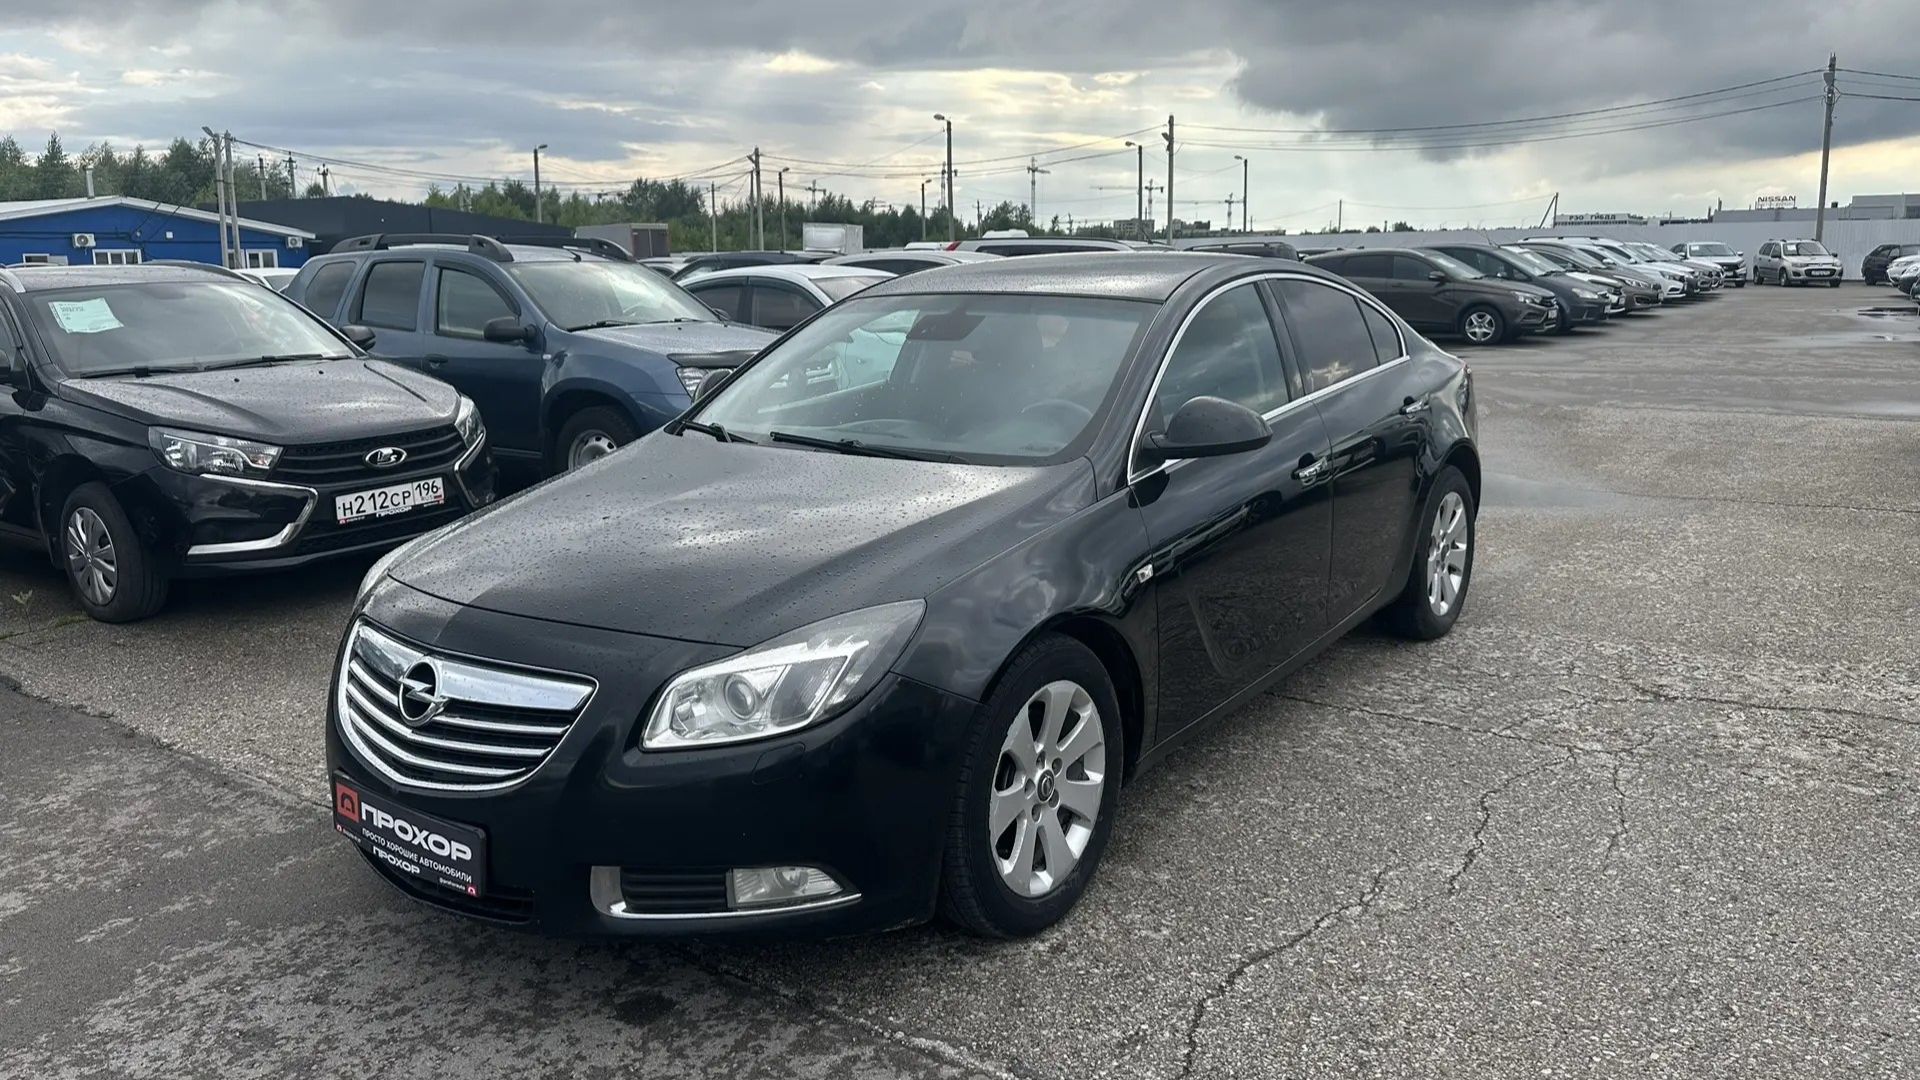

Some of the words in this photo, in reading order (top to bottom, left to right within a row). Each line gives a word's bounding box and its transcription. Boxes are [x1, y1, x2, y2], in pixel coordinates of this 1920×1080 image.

[415, 480, 439, 496] 196
[361, 802, 472, 861] ПРОХОР
[362, 828, 387, 847] ПРОСТО
[386, 840, 418, 863] ХОРОШИЕ
[419, 857, 472, 883] АВТОМОБИЛИ
[373, 846, 420, 874] ПРОХОР
